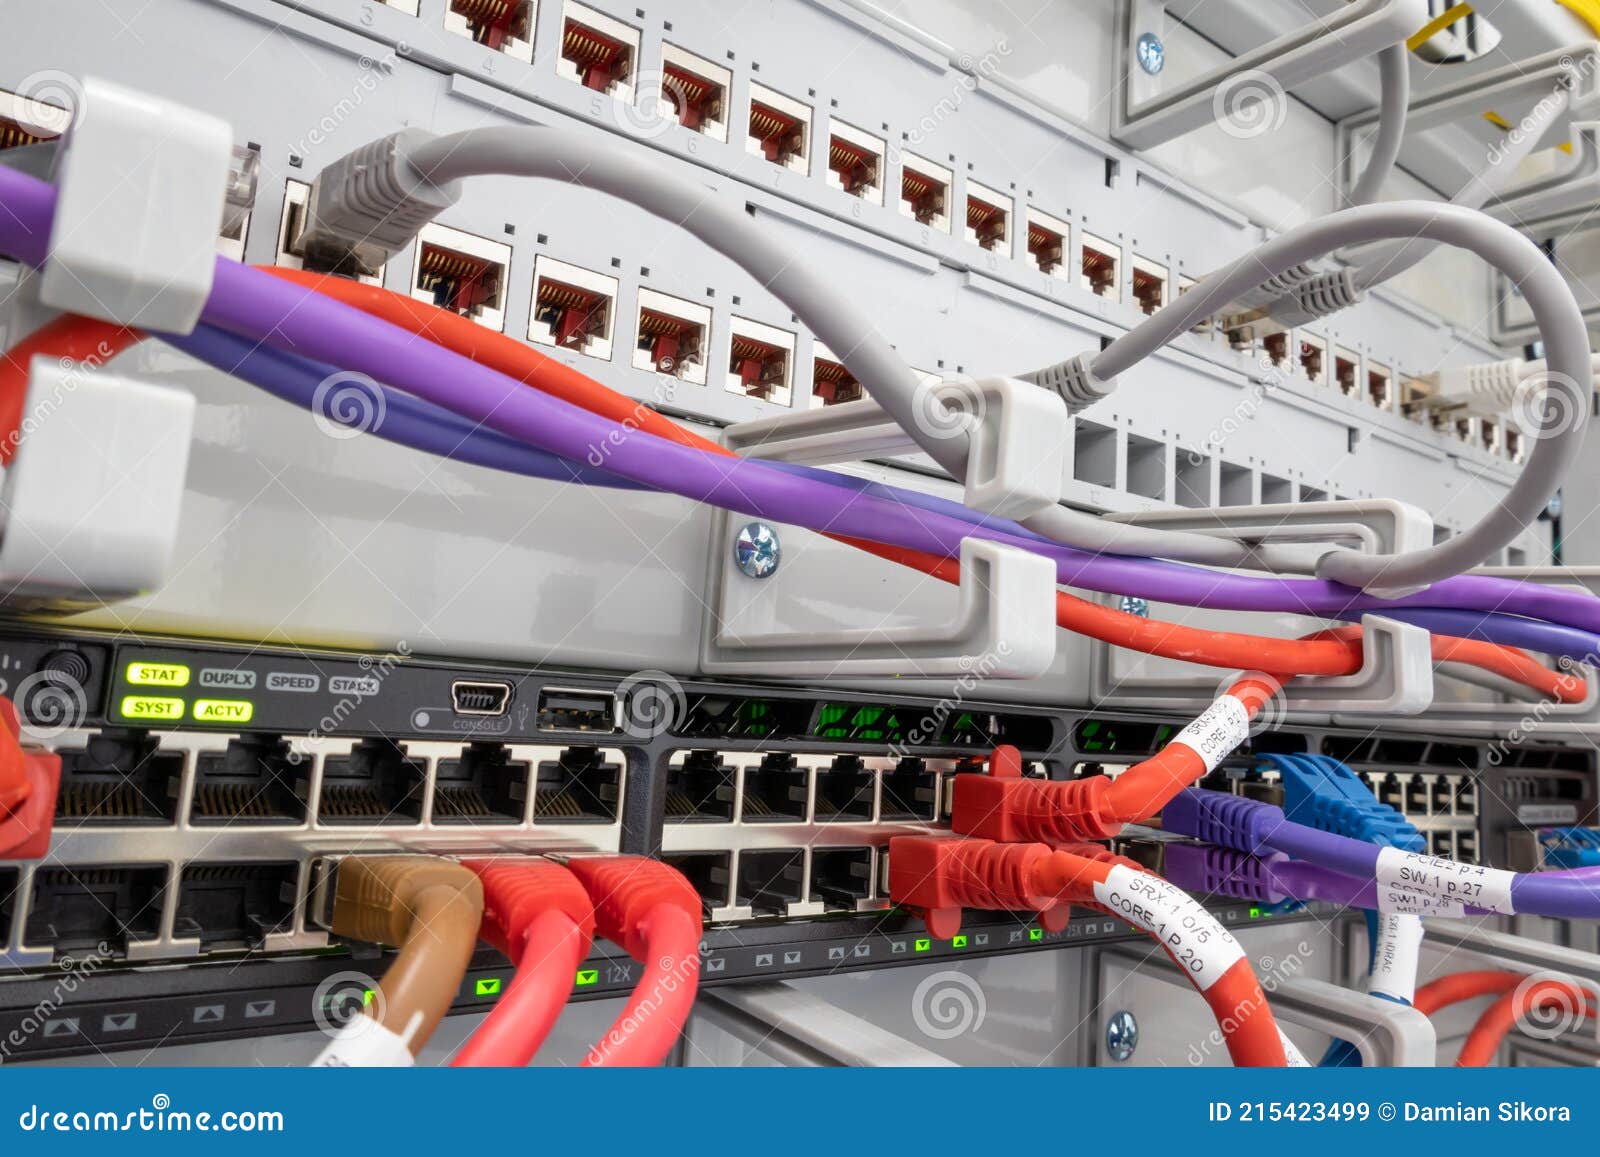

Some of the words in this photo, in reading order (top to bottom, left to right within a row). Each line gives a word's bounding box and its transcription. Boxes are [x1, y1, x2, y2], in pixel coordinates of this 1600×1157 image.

[140, 668, 178, 681] STAT
[203, 671, 254, 686] DUPLX
[270, 675, 315, 689] SPEED
[332, 679, 376, 692] STACK
[134, 701, 173, 714] SYST
[204, 704, 244, 717] ACTV
[453, 719, 504, 731] CONSOLE
[1399, 866, 1440, 888] SW.1
[1447, 880, 1483, 897] p.27
[1129, 878, 1180, 915] SRX-1
[1388, 892, 1418, 905] SW1
[1109, 892, 1167, 934] CORE-1
[1167, 932, 1205, 973] P.20
[606, 965, 632, 984] 12X
